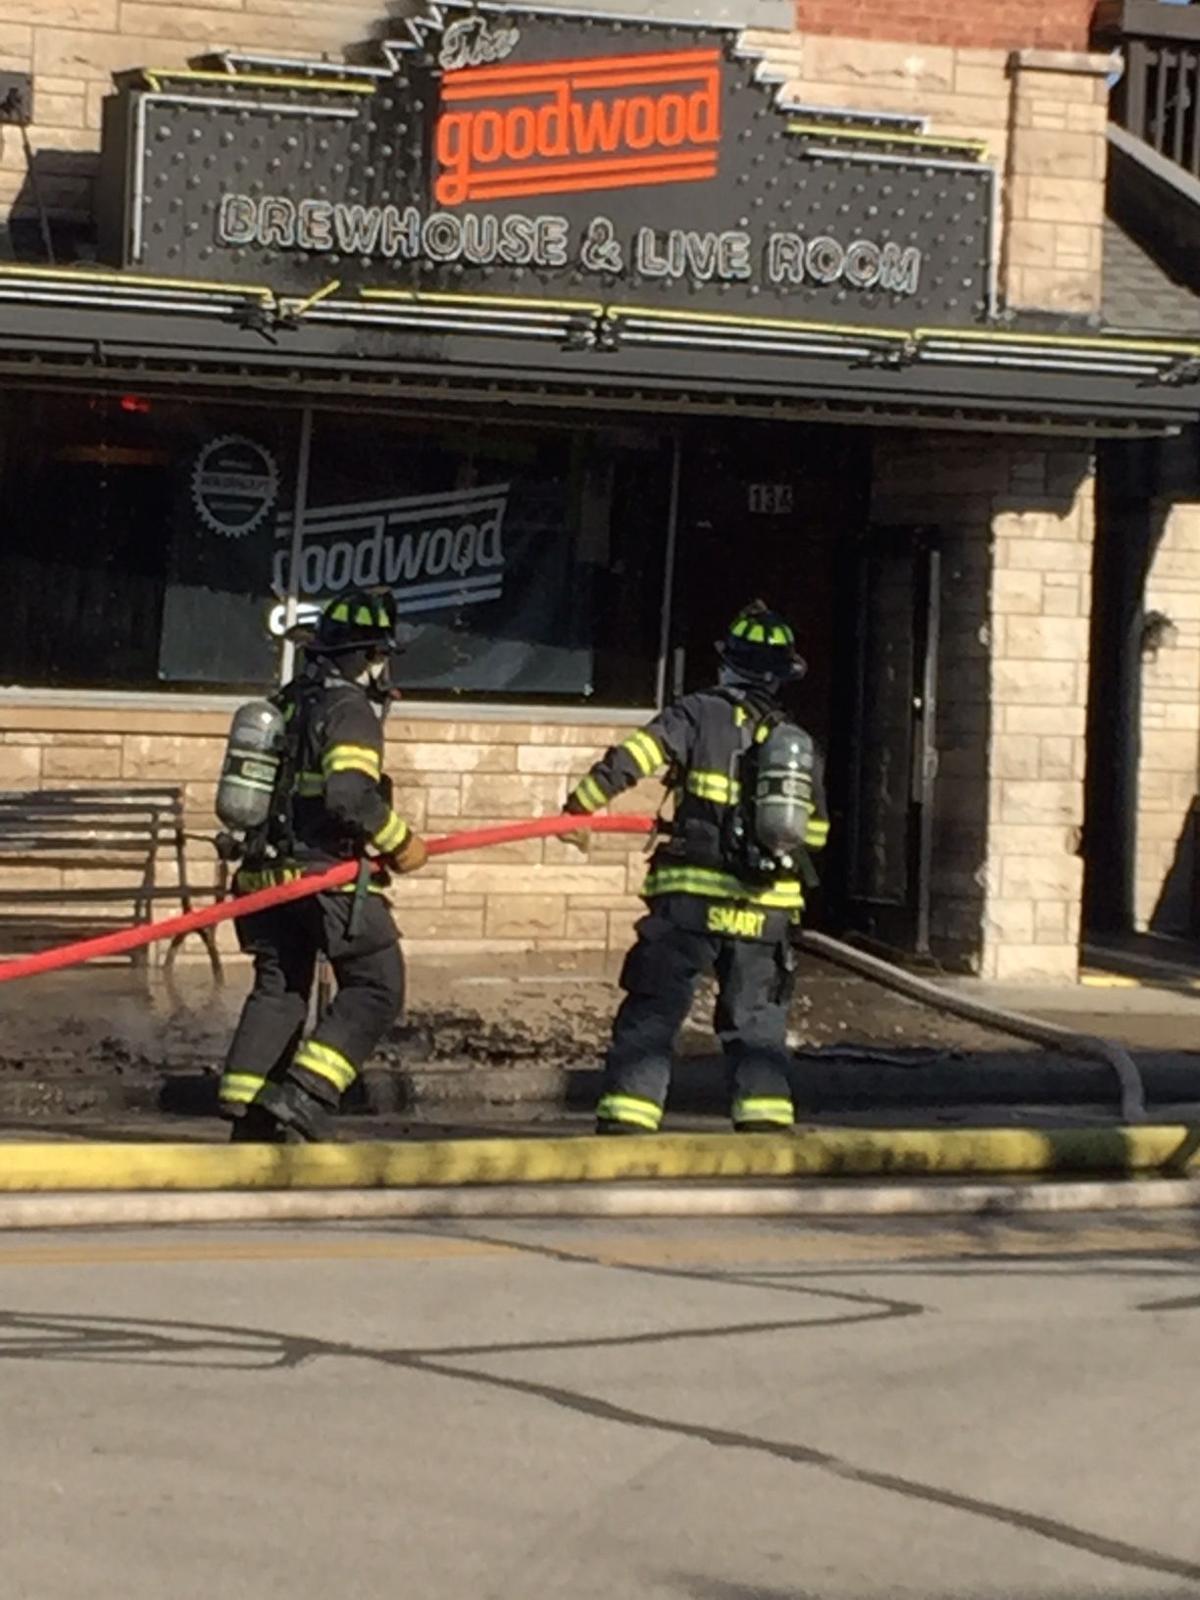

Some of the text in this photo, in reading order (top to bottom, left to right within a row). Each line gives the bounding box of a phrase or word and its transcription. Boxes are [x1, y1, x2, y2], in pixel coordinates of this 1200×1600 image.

[438, 15, 519, 70] The
[434, 66, 720, 206] goodwood
[219, 194, 921, 294] BREWHOUSE & LIVE ROOM
[707, 906, 766, 938] SMART
